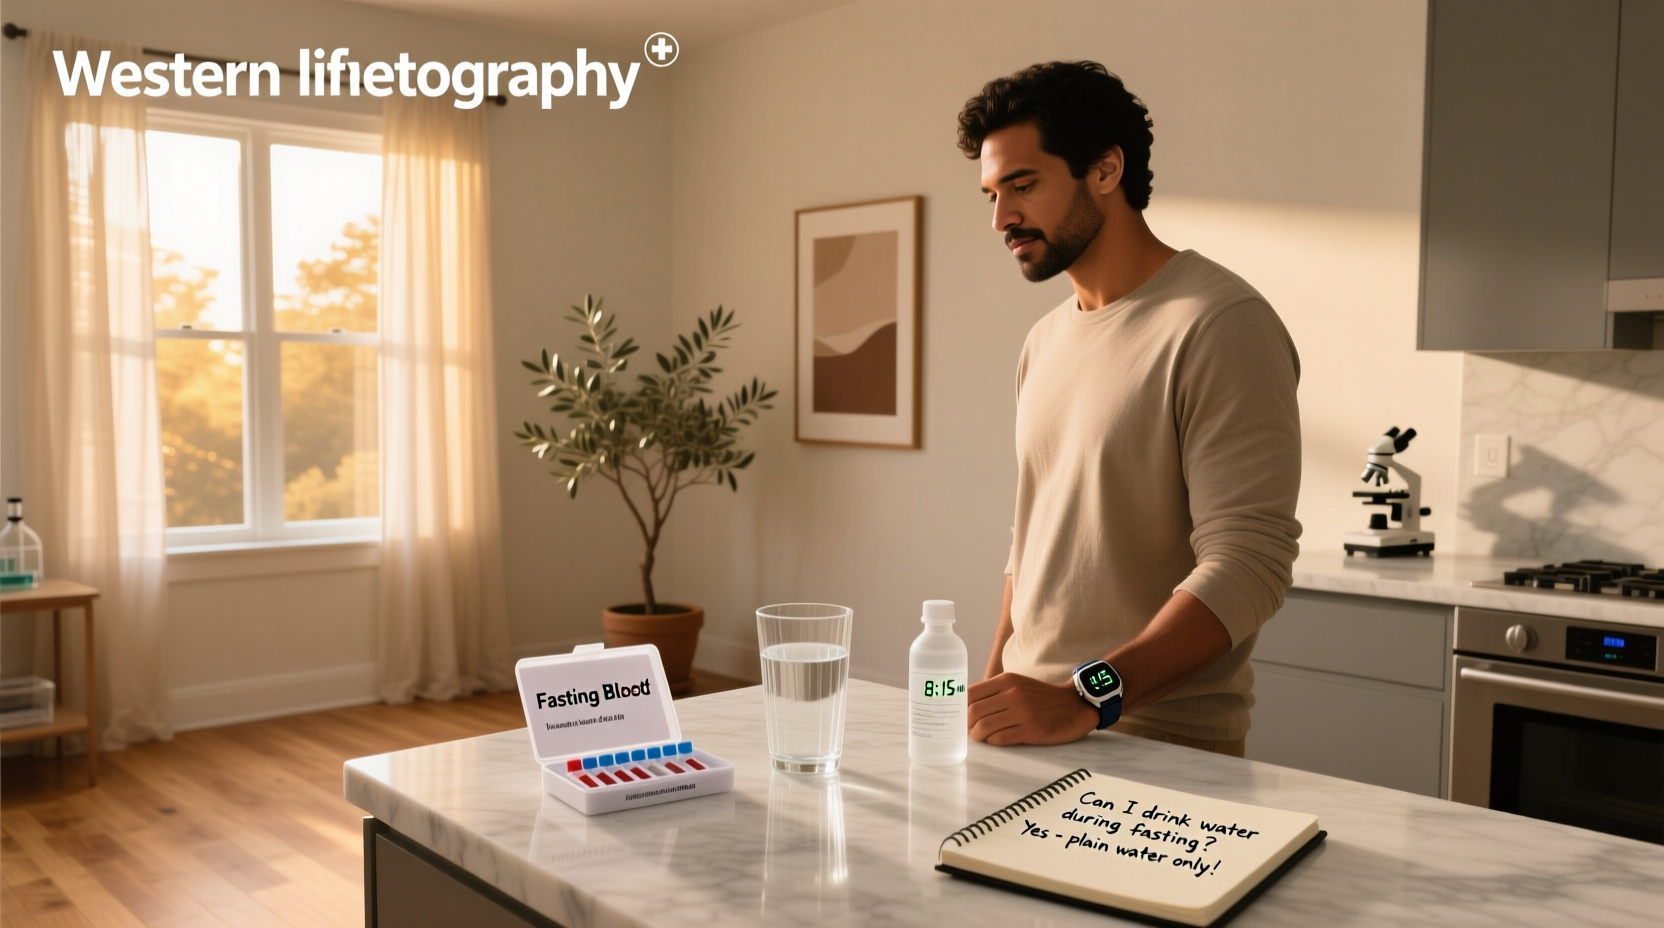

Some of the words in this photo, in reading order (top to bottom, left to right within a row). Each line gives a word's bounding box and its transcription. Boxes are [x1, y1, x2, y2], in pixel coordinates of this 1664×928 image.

[536, 688, 600, 709] Fasting
[925, 679, 955, 697] 8:15
[1061, 808, 1122, 834] during
[1129, 823, 1217, 853] fasting?
[1079, 791, 1115, 811] Can
[1122, 800, 1138, 815] I
[1142, 805, 1192, 827] drink
[1200, 820, 1260, 840] water
[1021, 819, 1049, 839] Yes
[1065, 833, 1109, 852] plain
[1116, 845, 1168, 863] water
[1172, 857, 1222, 878] only!
